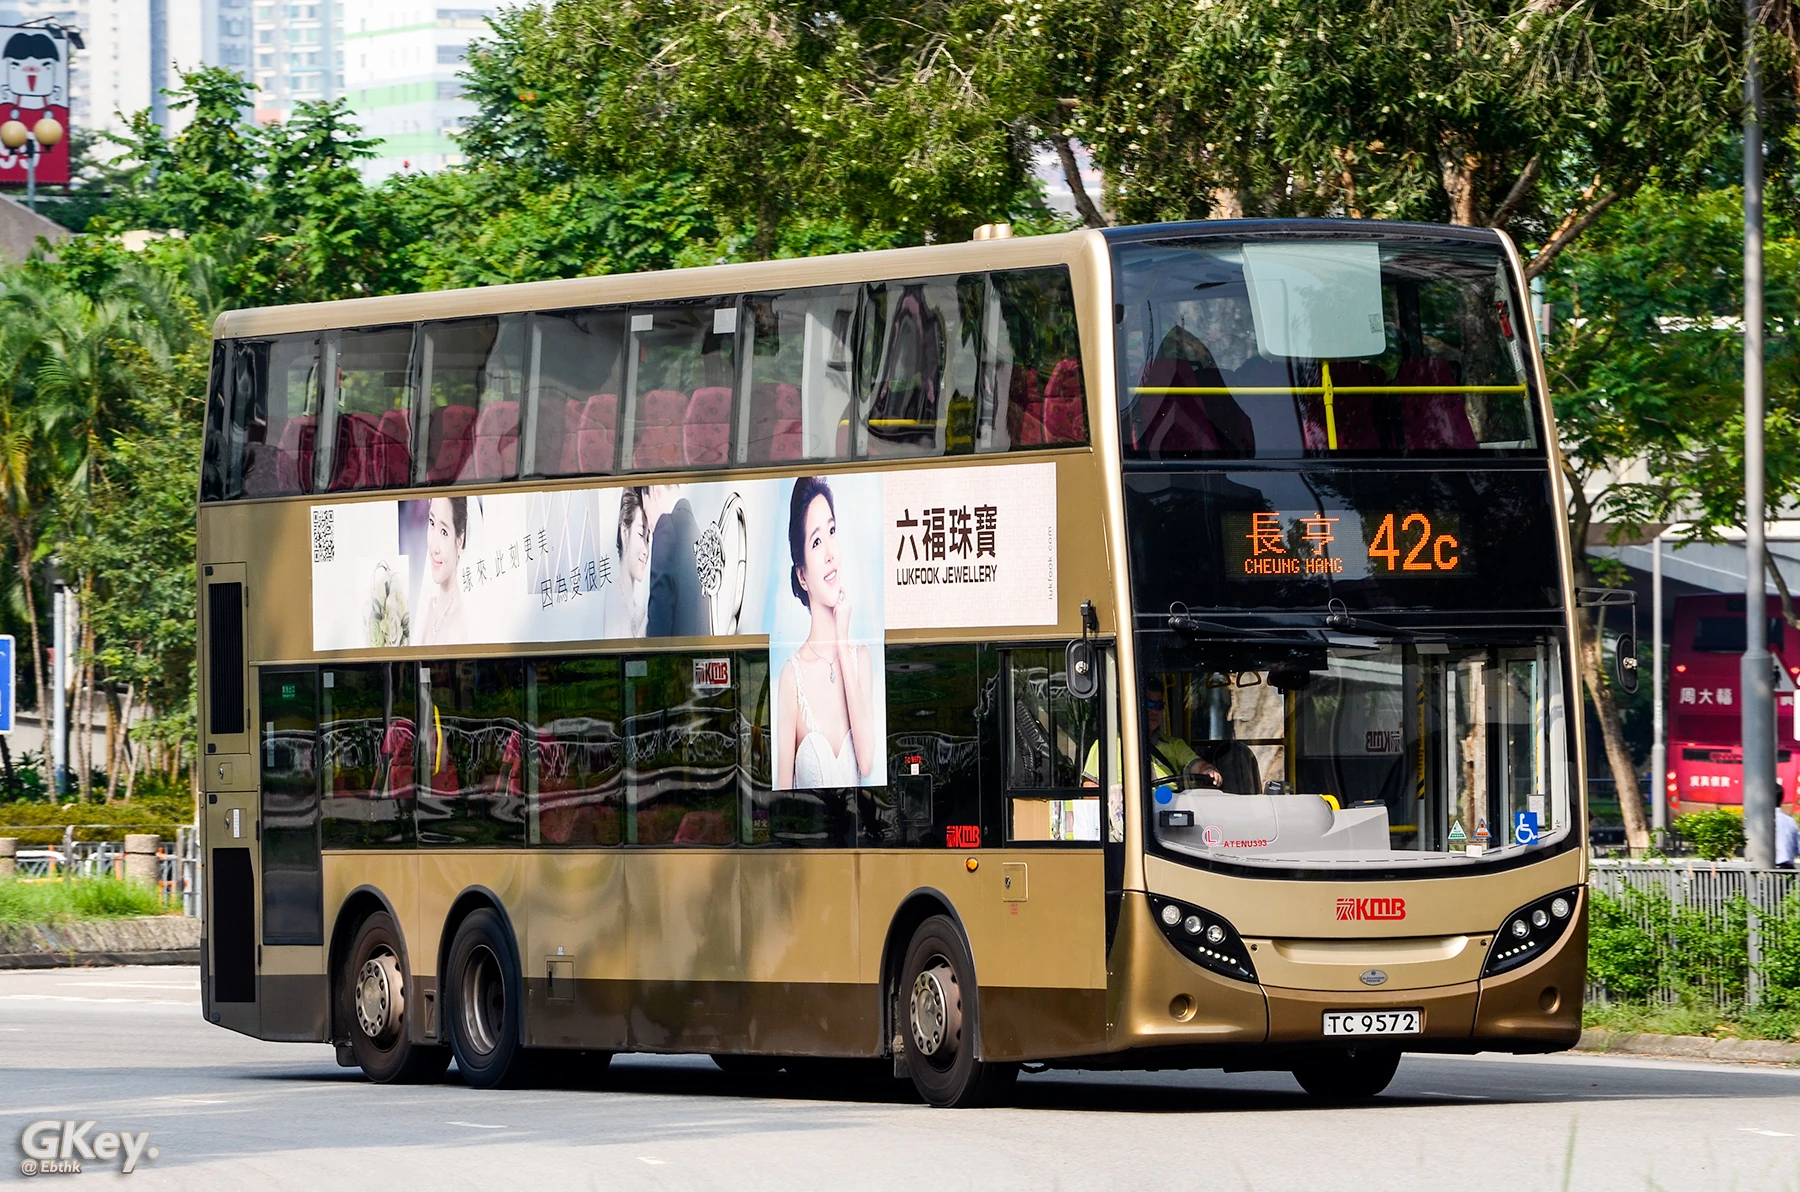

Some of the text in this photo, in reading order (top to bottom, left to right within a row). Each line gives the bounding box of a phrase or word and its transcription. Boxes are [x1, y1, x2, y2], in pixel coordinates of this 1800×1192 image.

[896, 504, 998, 561] 六福珠寶
[1246, 512, 1340, 556] 長亨
[896, 564, 998, 585] LUKFOOK JEWELLERY
[1244, 557, 1344, 574] CHEUNG HANG
[540, 554, 613, 611] 因為愛很美
[705, 662, 729, 685] KMB
[956, 825, 980, 848] KMB
[1223, 839, 1268, 848] ATENU393
[1356, 898, 1406, 920] KMB
[1328, 1013, 1414, 1033] TC 9572
